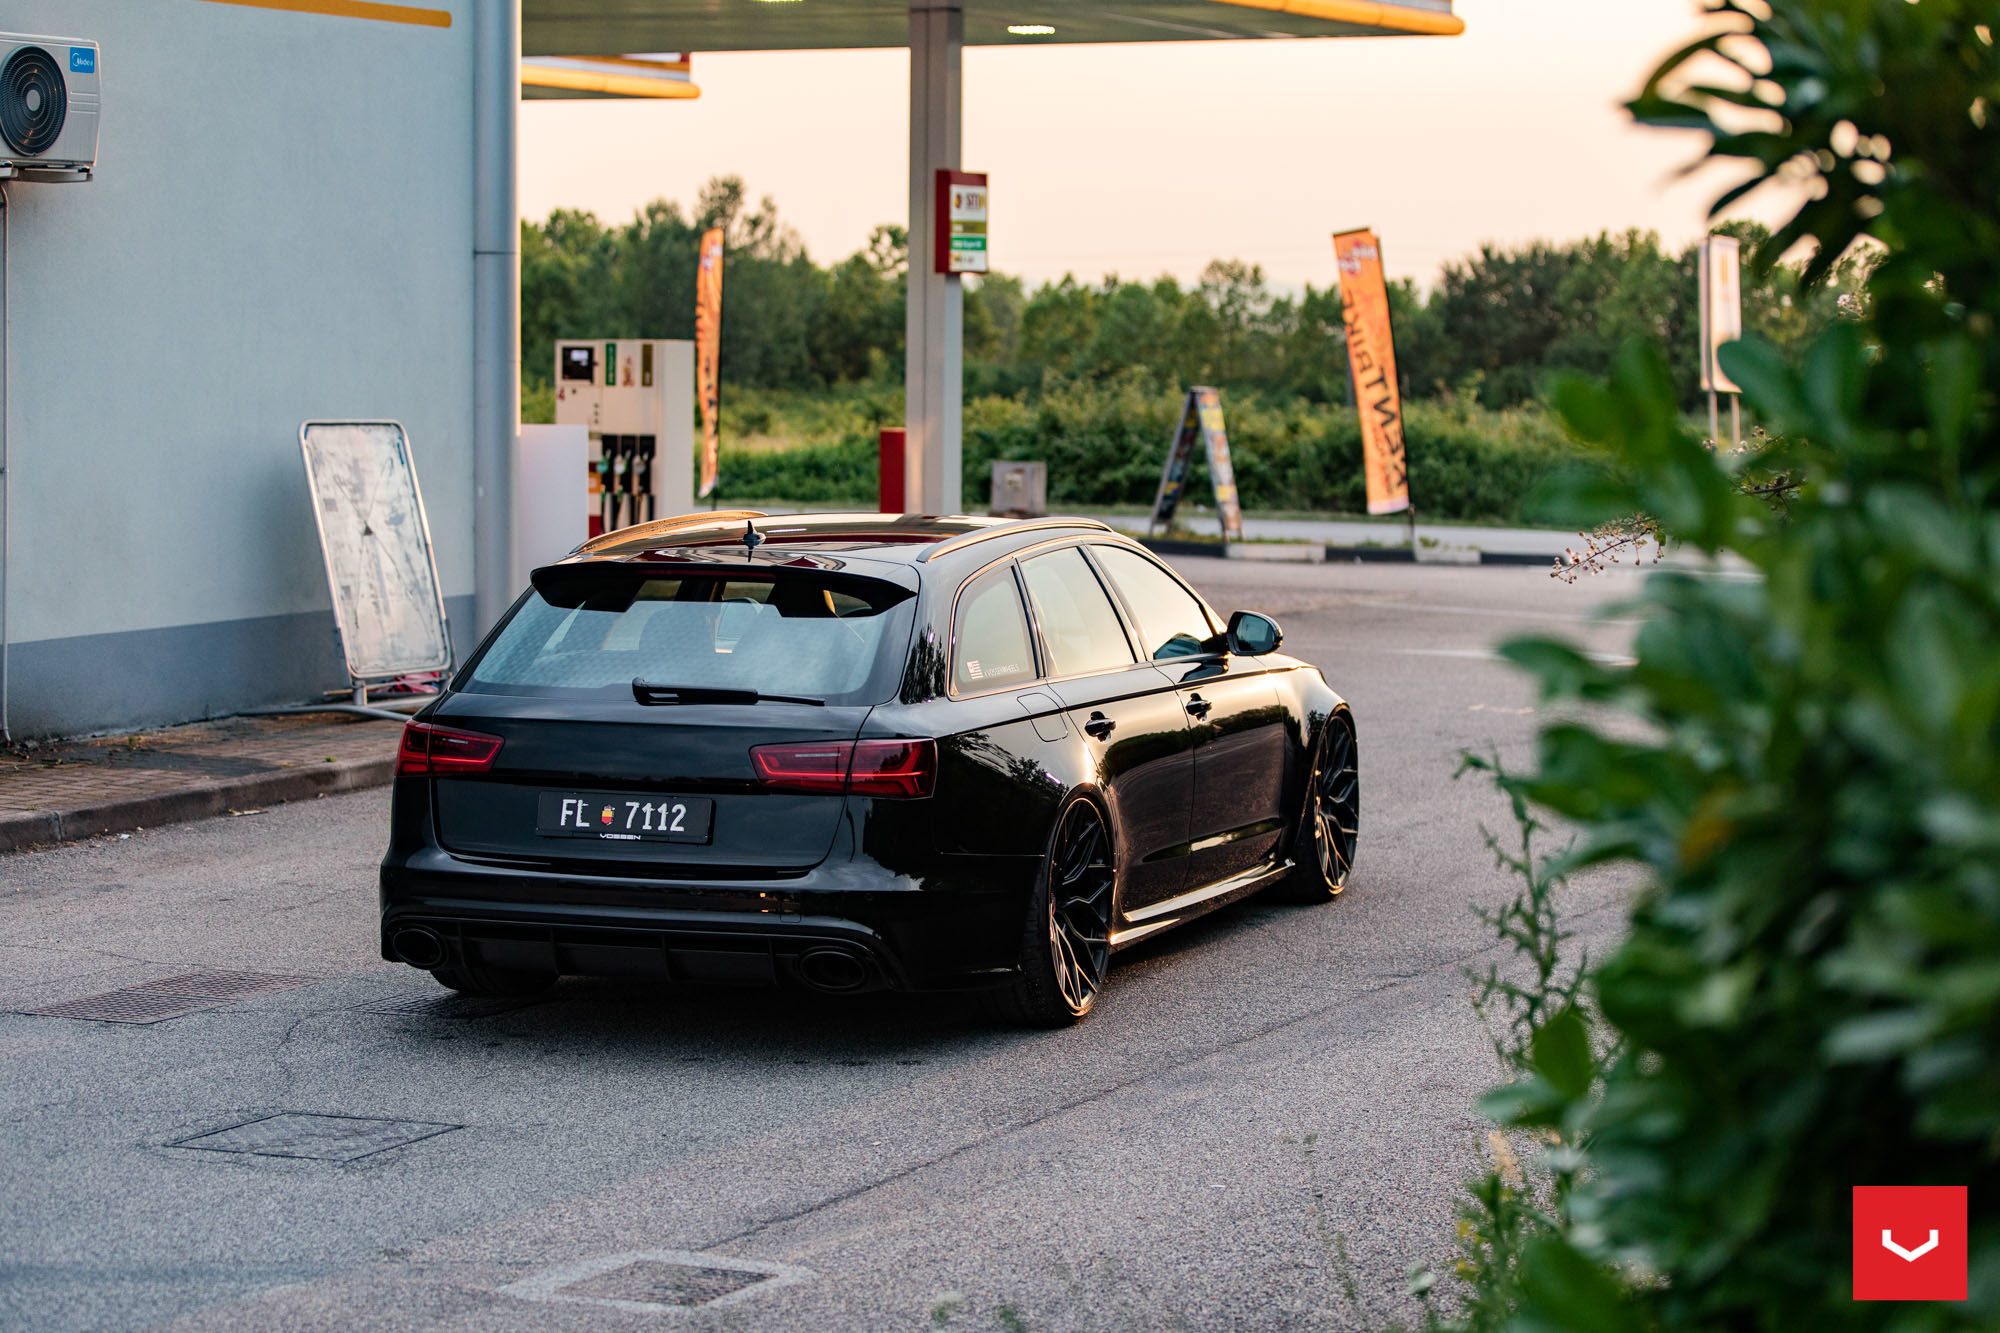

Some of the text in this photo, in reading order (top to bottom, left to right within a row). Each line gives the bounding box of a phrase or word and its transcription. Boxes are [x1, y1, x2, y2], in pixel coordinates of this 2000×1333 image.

[560, 799, 687, 832] FL 7112
[599, 833, 641, 841] VOSSEN
